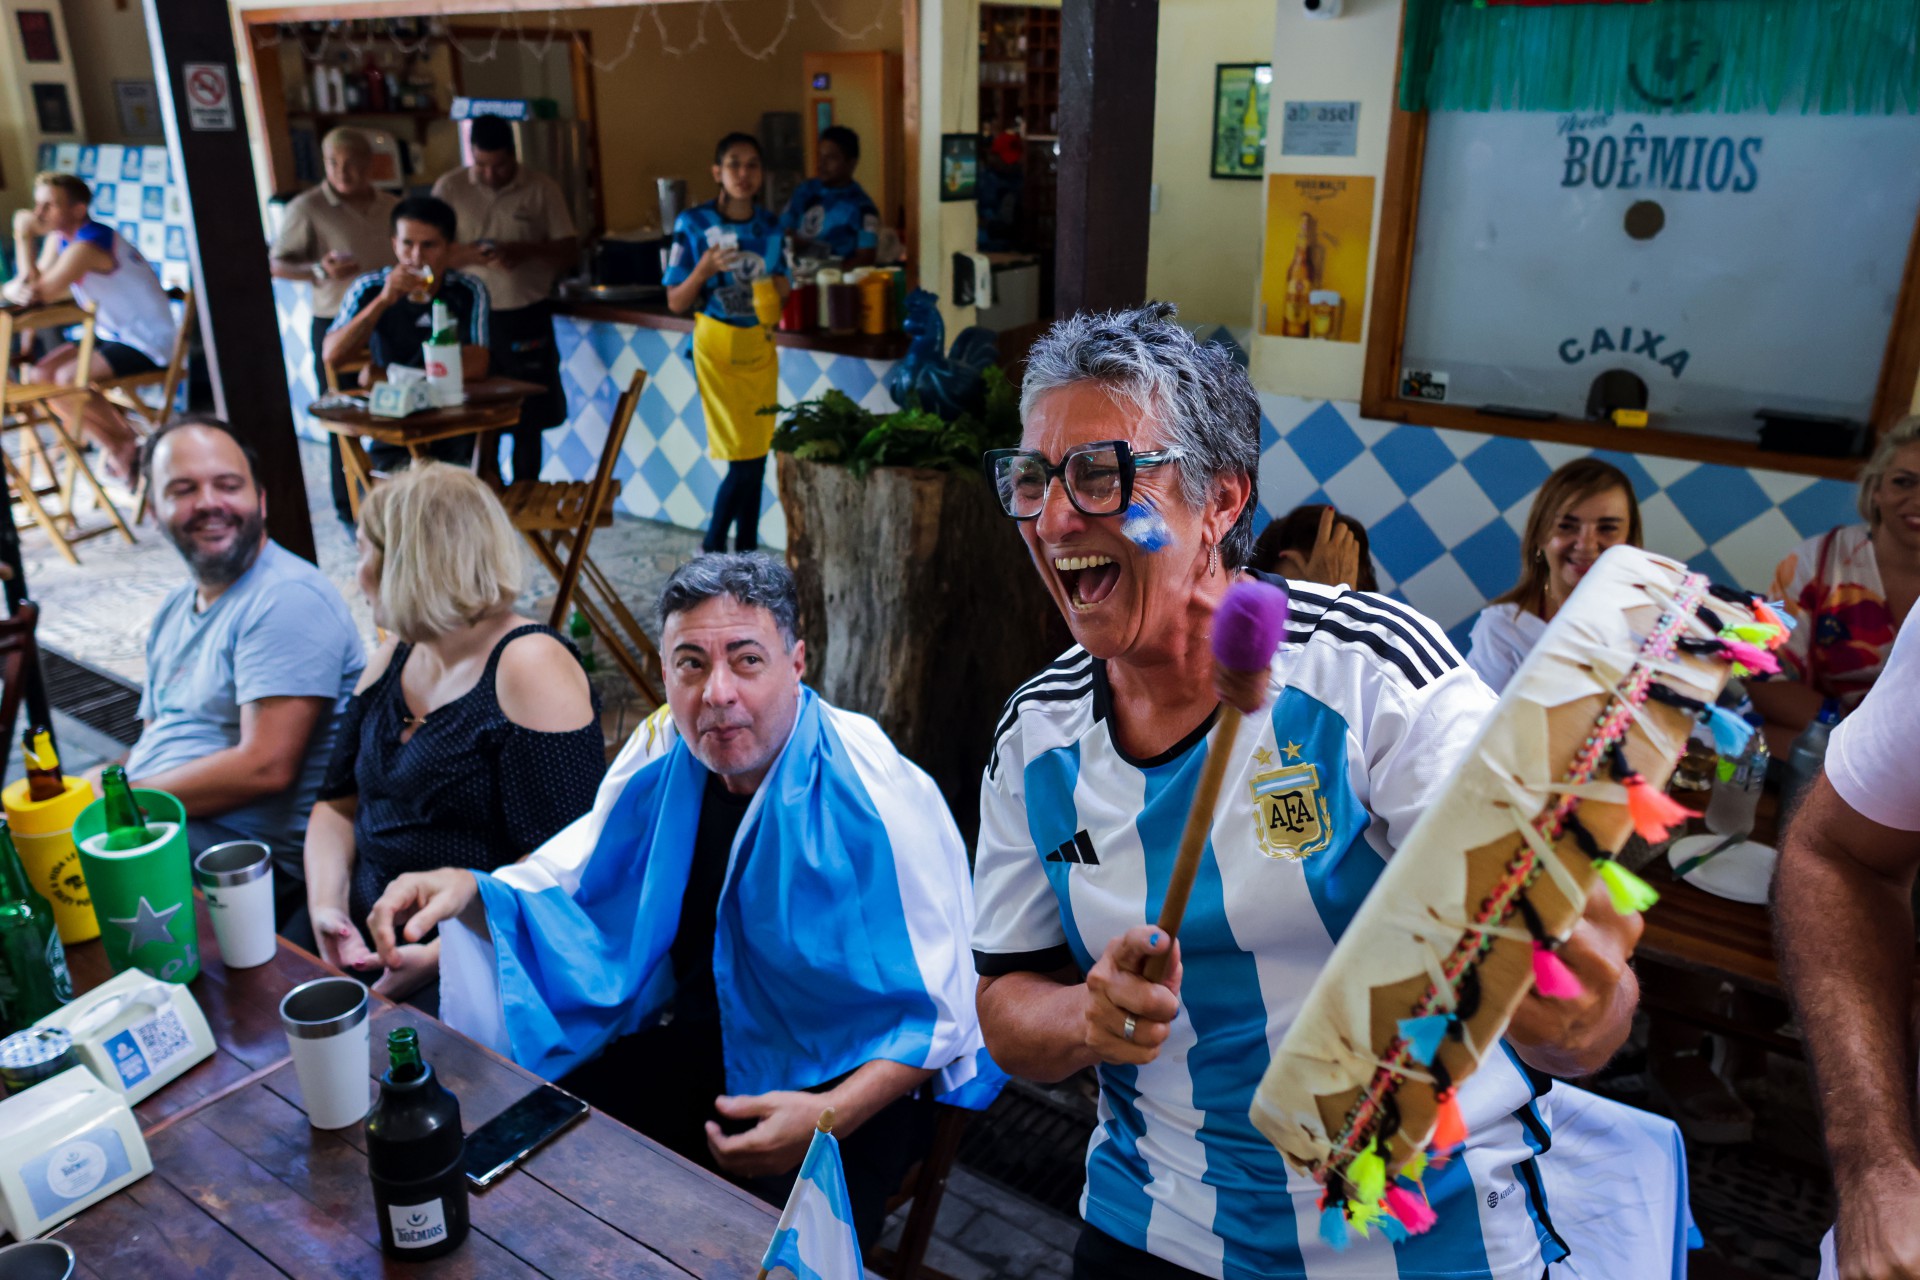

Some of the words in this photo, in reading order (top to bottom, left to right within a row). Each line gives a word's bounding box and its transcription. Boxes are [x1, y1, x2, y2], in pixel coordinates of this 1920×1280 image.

[1560, 122, 1763, 193] BOÊMIOS
[1558, 326, 1690, 379] CAIXA
[1270, 790, 1315, 833] AFA
[398, 1224, 443, 1242] BOÊMIOS
